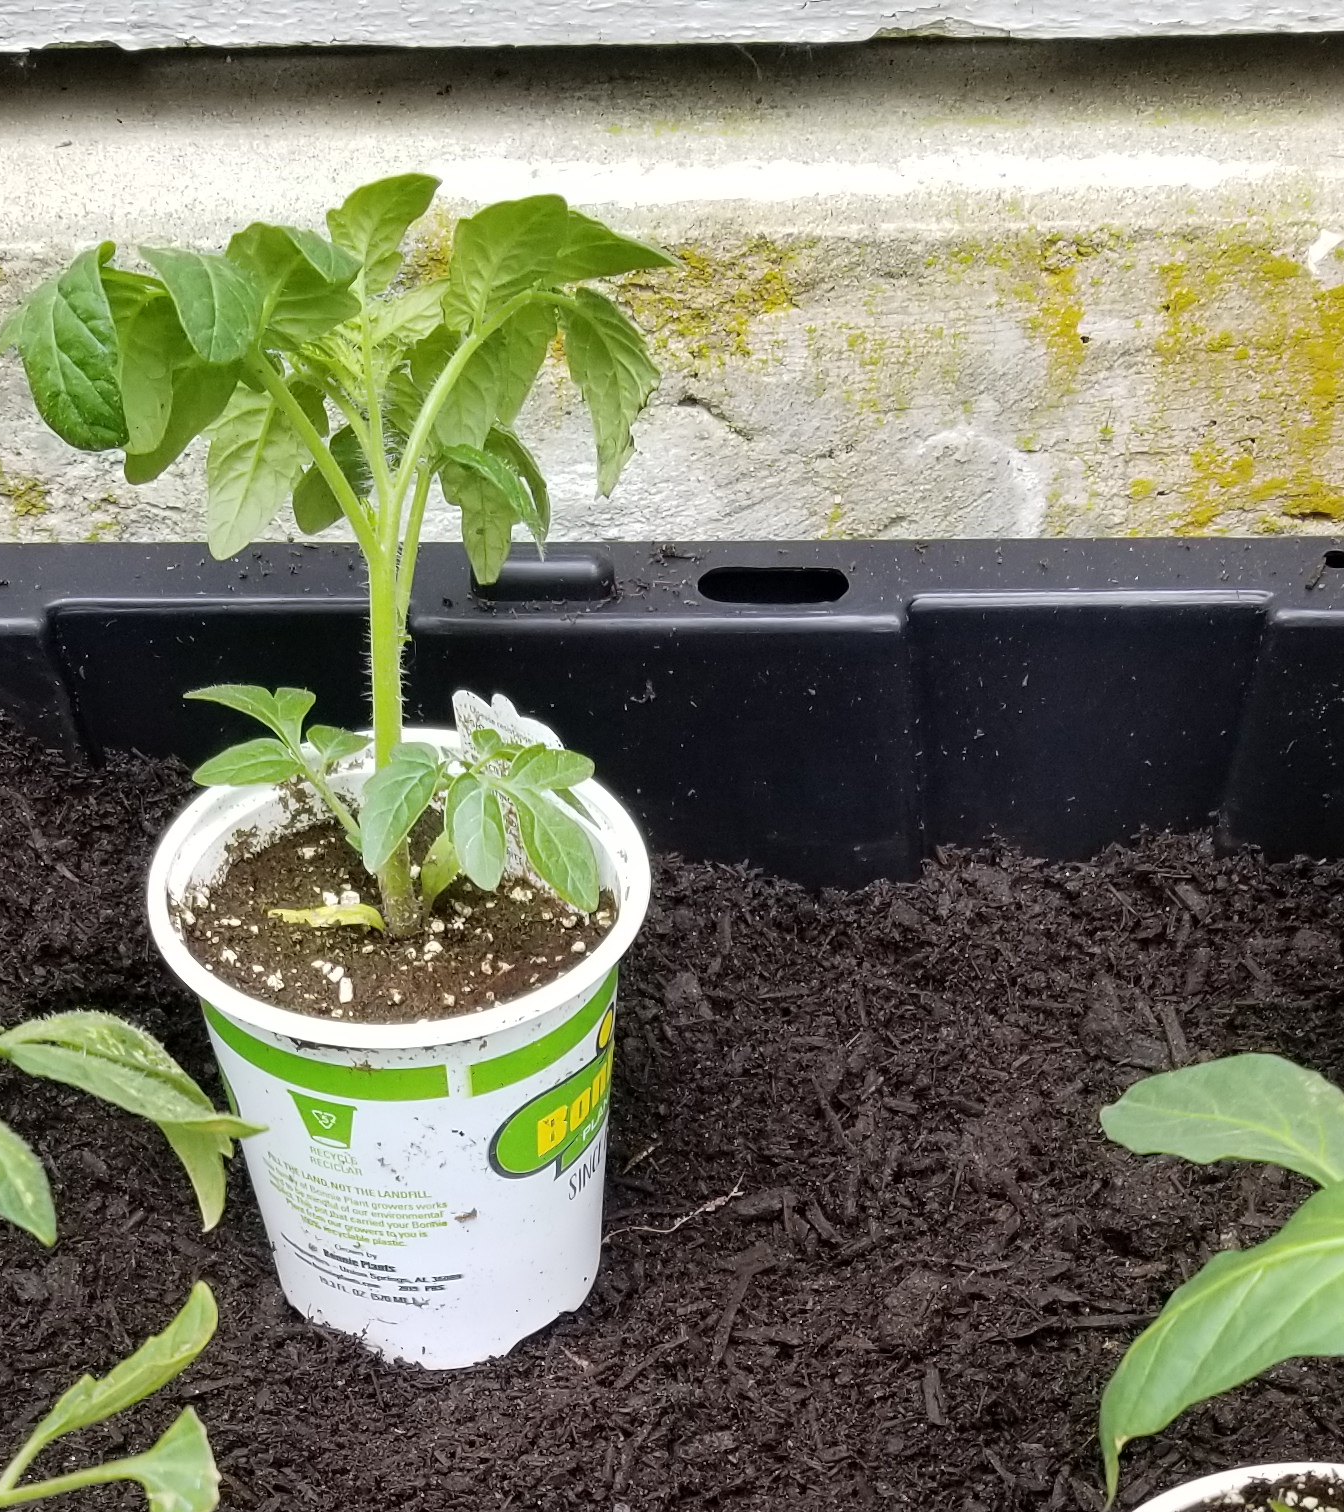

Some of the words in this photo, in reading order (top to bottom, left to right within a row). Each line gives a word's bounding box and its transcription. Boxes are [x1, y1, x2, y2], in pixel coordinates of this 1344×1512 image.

[309, 1146, 358, 1166] RECYCLE
[309, 1156, 363, 1177] RECICLAR
[330, 1181, 351, 1194] NOT
[354, 1186, 376, 1197] THE
[371, 1202, 414, 1211] growers
[415, 1202, 448, 1210] works
[352, 1208, 368, 1216] our
[370, 1210, 445, 1219] environmental
[386, 1222, 409, 1230] your
[411, 1221, 448, 1229] Bonnie
[397, 1231, 417, 1239] you
[359, 1260, 397, 1273] Plants
